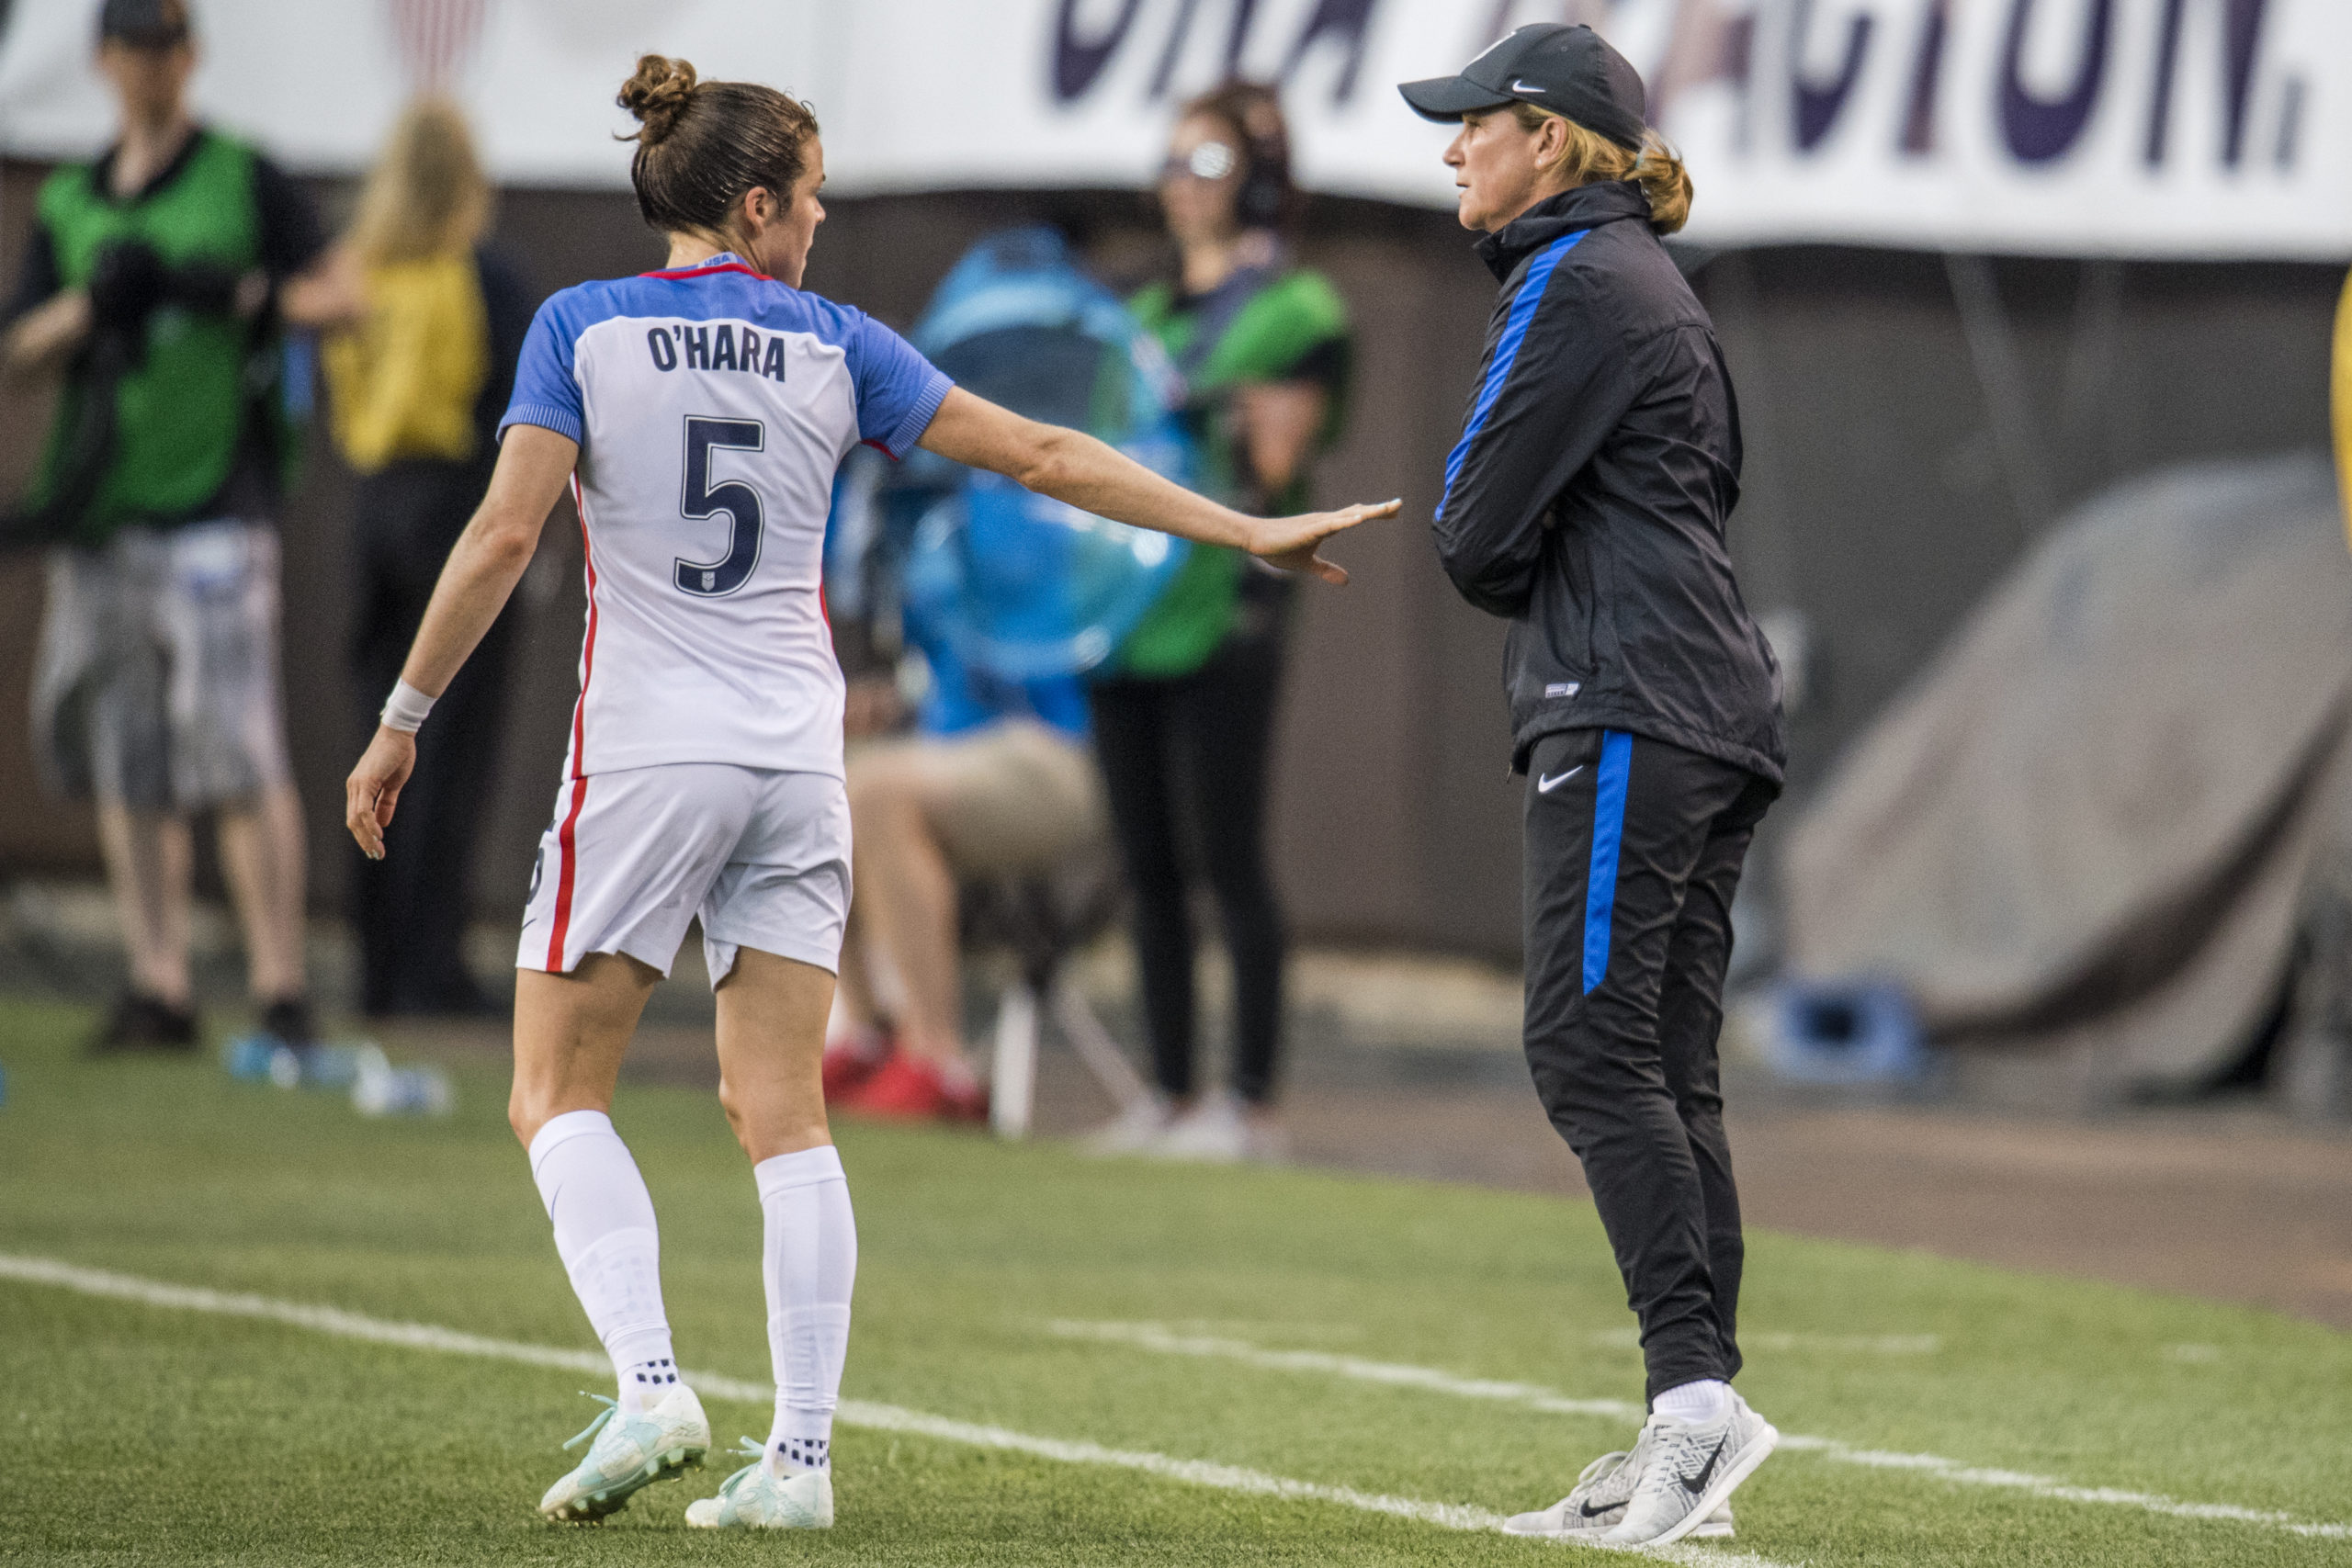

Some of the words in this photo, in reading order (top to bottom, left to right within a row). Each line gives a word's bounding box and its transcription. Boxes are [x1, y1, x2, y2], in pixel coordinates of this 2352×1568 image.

[704, 254, 731, 266] USA
[647, 324, 786, 383] O'HARA
[673, 414, 765, 598] 5
